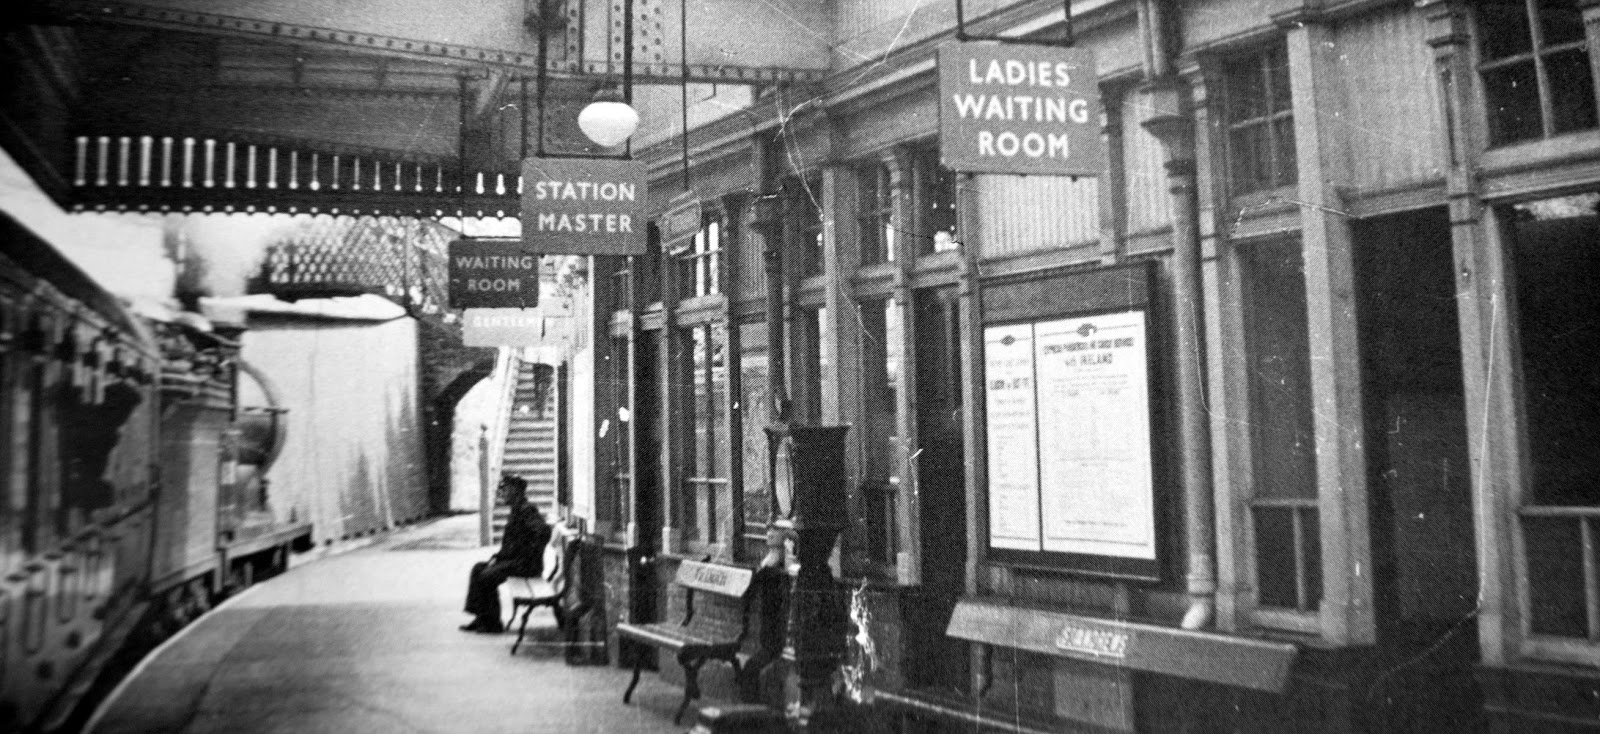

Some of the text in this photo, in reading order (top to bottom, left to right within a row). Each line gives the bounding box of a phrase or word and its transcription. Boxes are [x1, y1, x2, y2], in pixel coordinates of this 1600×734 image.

[969, 58, 1070, 87] LADIES
[953, 93, 1088, 123] WAITING
[979, 130, 1069, 158] ROOM
[535, 180, 636, 201] STATION
[537, 213, 633, 233] MASTER
[455, 255, 533, 270] WAITING
[467, 277, 521, 292] ROOM
